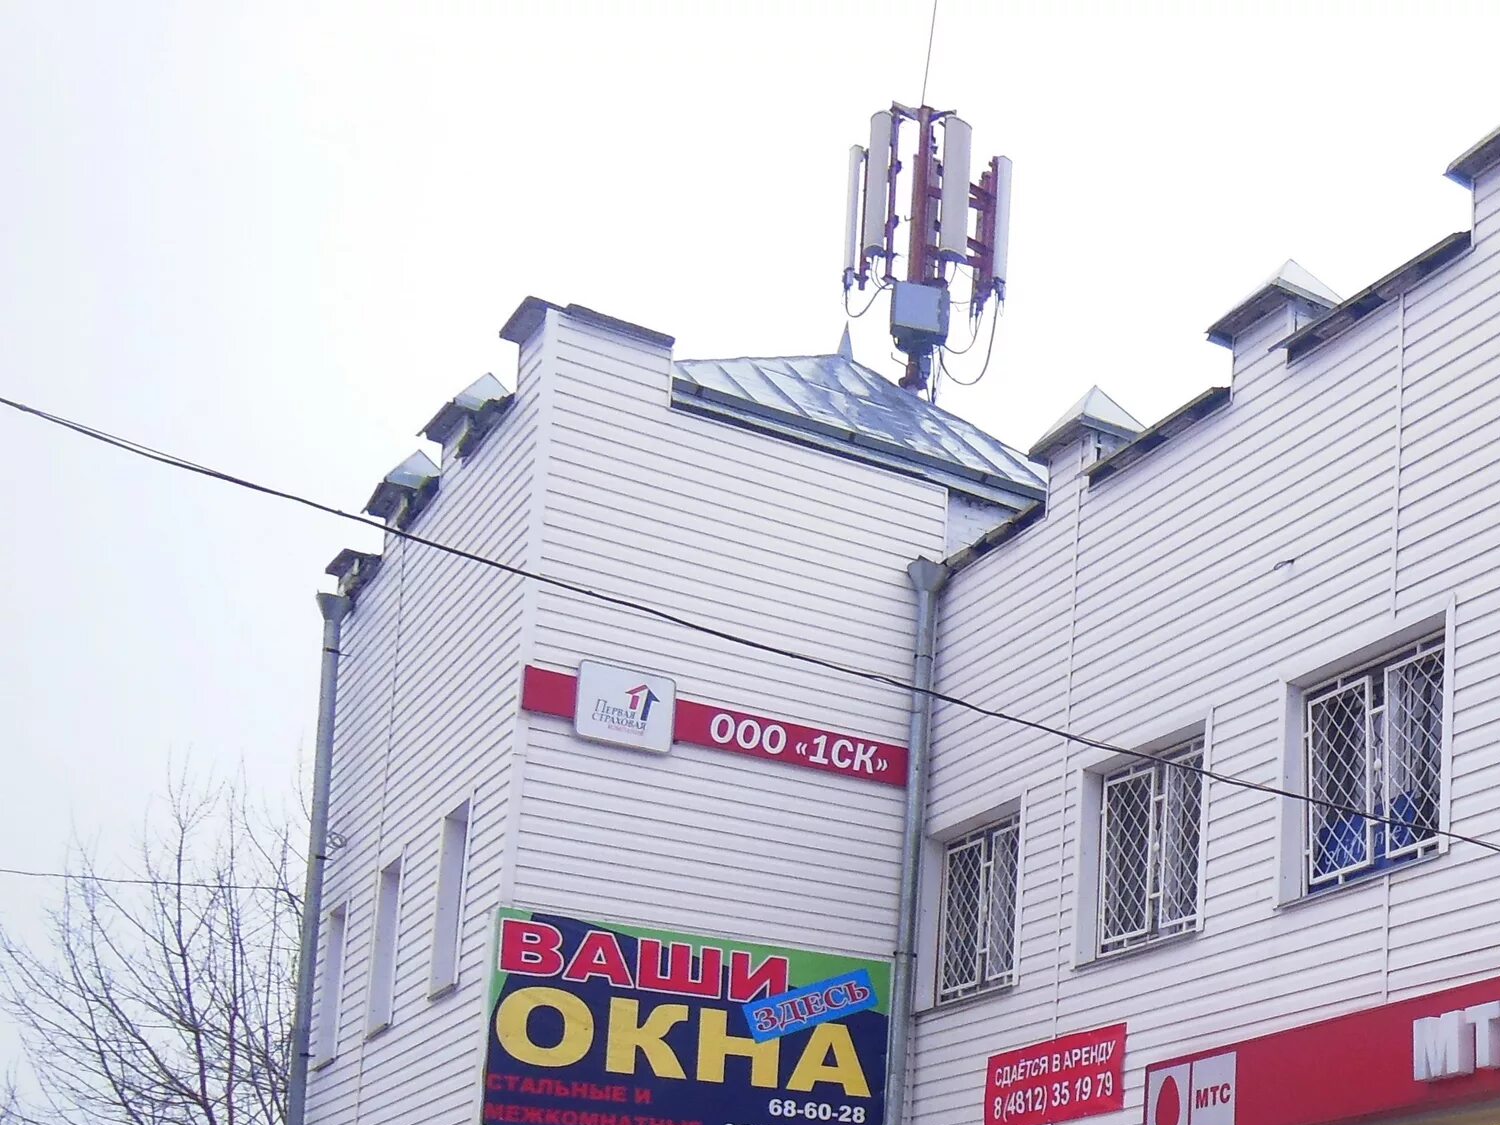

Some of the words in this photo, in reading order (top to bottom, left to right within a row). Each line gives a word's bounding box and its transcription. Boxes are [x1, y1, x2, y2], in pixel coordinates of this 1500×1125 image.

[709, 713, 787, 755] ООО
[795, 733, 889, 775] «1СК»
[498, 917, 790, 1003] ВАШИ
[753, 977, 871, 1034] ЗДЕСЬ
[496, 985, 872, 1098] ОКНА
[995, 1055, 1049, 1088] СДАЁТСЯ
[1052, 1054, 1061, 1072] В
[1063, 1040, 1116, 1070] АРЕНДУ
[486, 1073, 627, 1103] СТАЛЬНЫЕ
[635, 1088, 653, 1105] И
[768, 1098, 866, 1124] 68-60-28
[1051, 1081, 1070, 1107] 35
[1075, 1076, 1092, 1102] 19
[1096, 1071, 1113, 1098] 79
[1196, 1083, 1230, 1109] МТС
